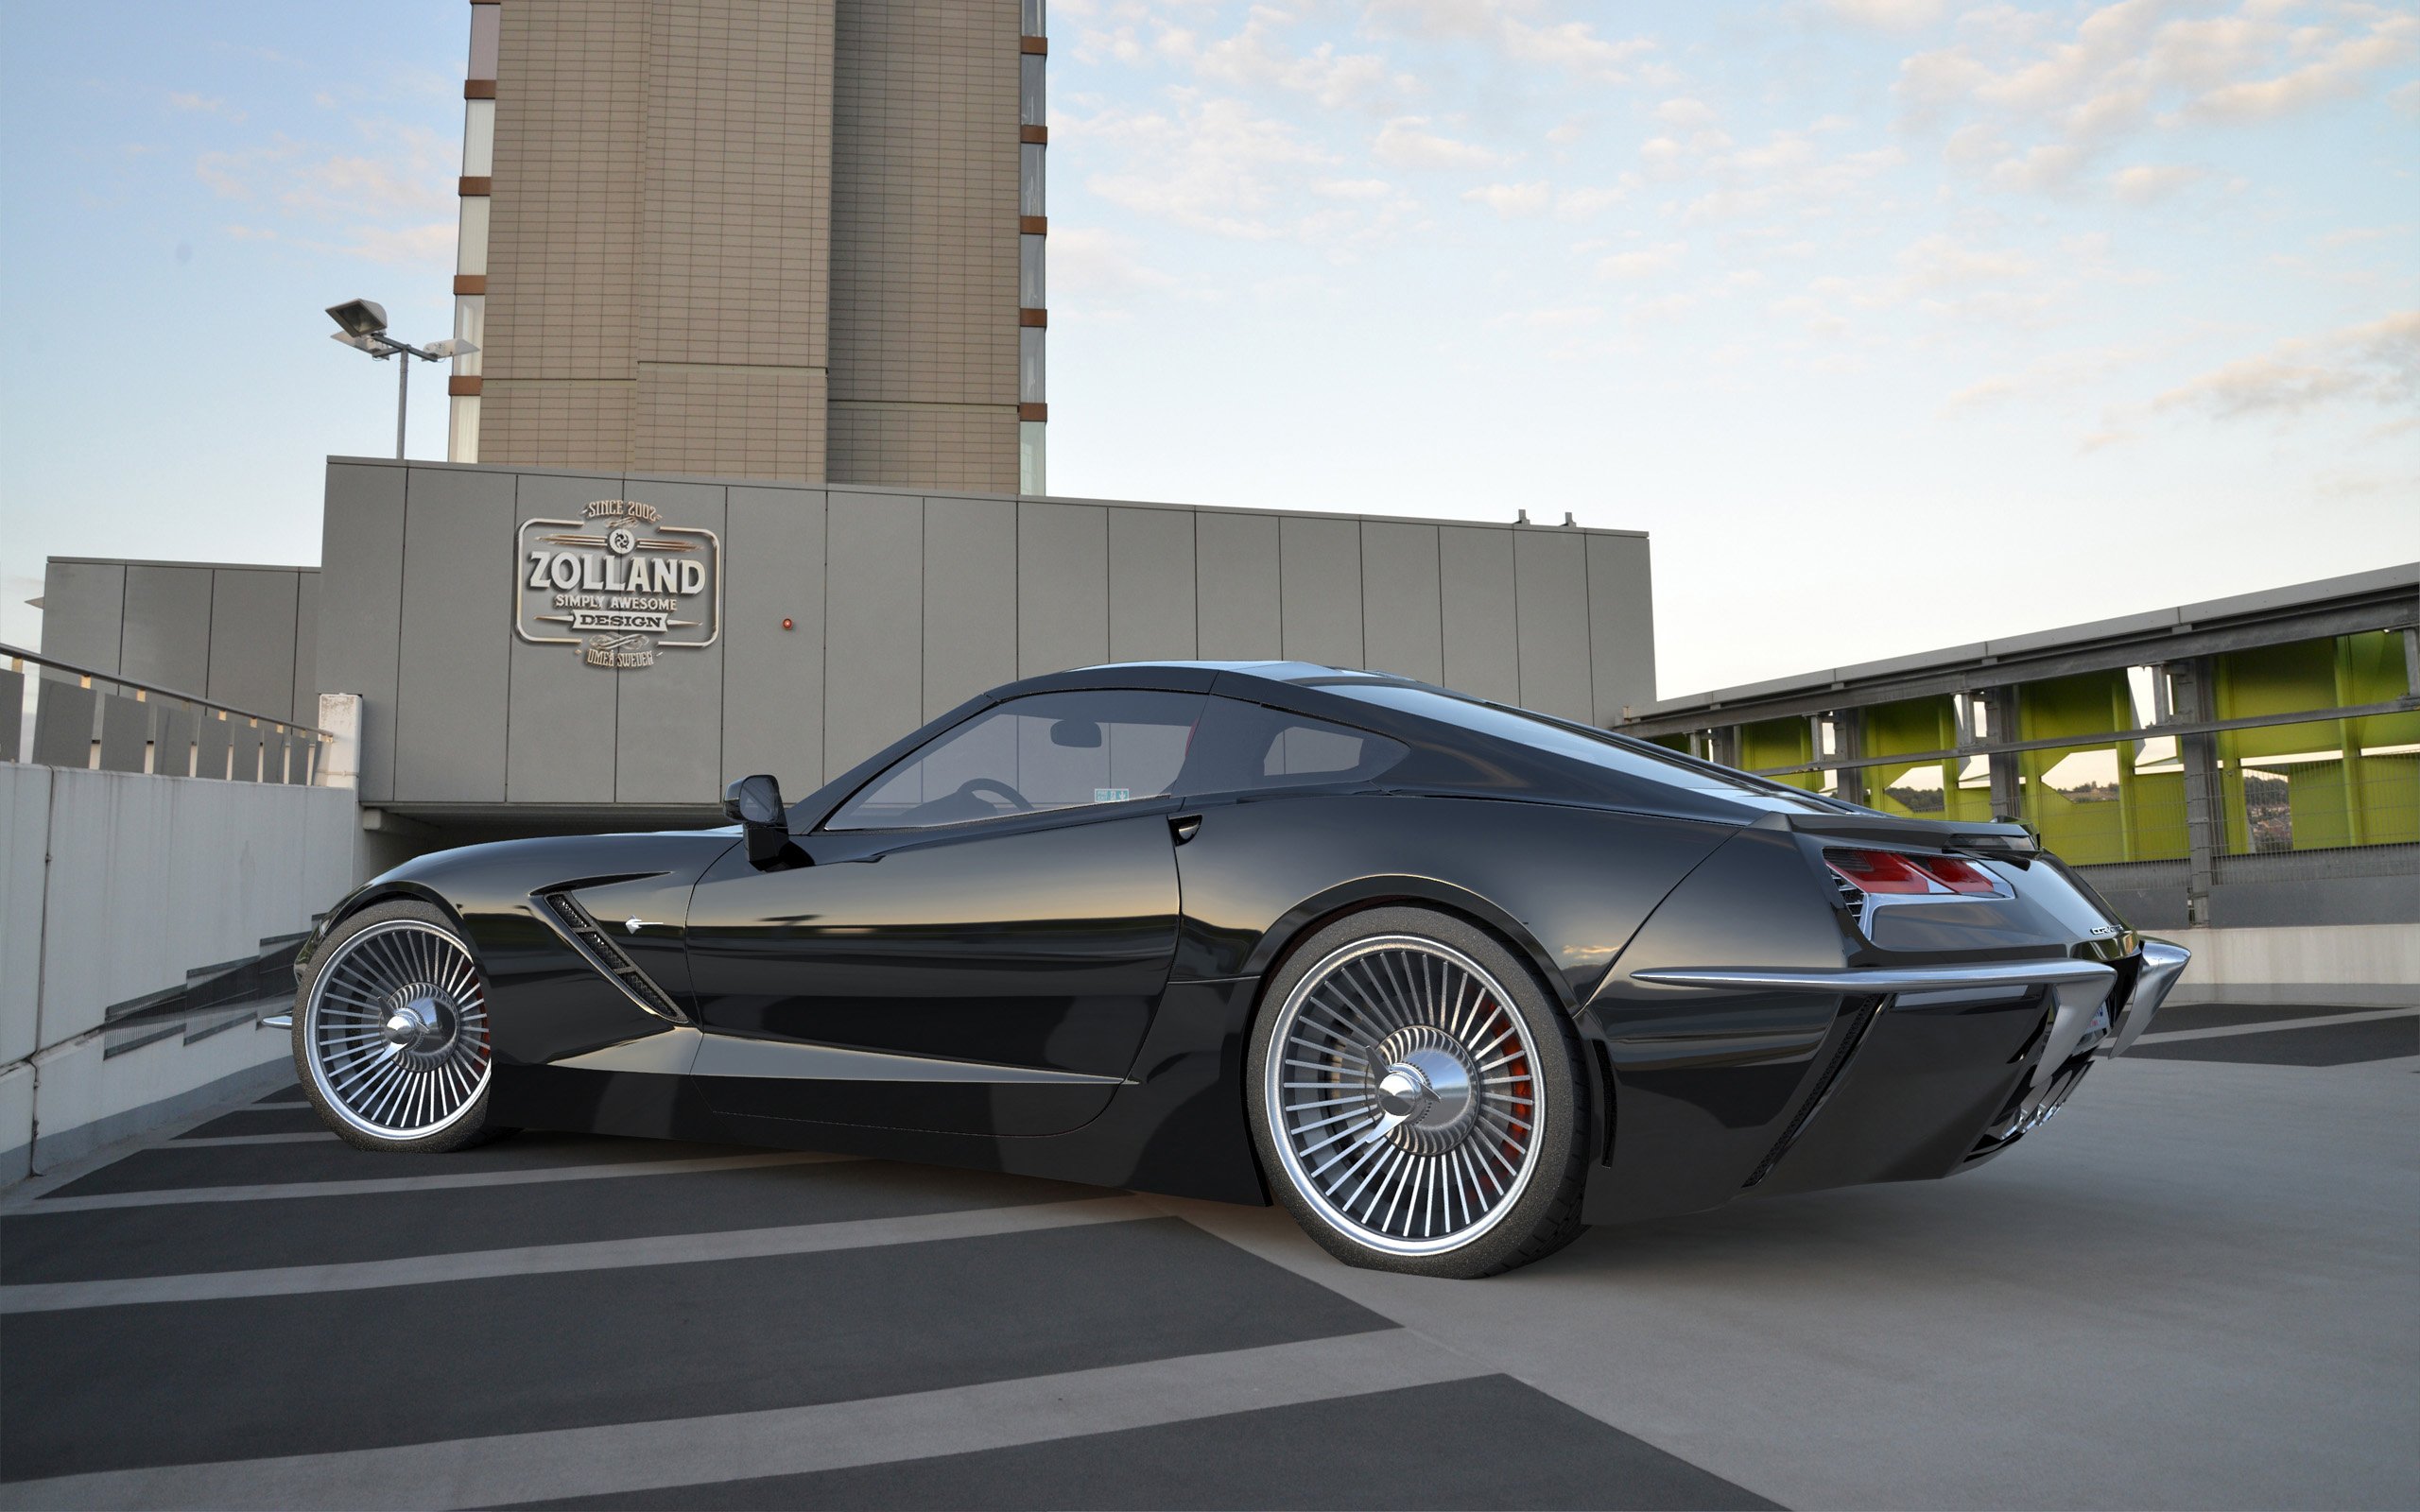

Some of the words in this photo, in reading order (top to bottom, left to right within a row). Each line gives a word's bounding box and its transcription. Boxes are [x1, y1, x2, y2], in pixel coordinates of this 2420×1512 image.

[588, 499, 624, 517] SINCE
[628, 501, 656, 522] 2002
[529, 551, 706, 594] ZOLLAND
[555, 593, 605, 610] SIMPLY
[610, 596, 678, 610] AWESOME
[579, 614, 662, 627] DESIGN
[616, 650, 653, 667] SWEDEN
